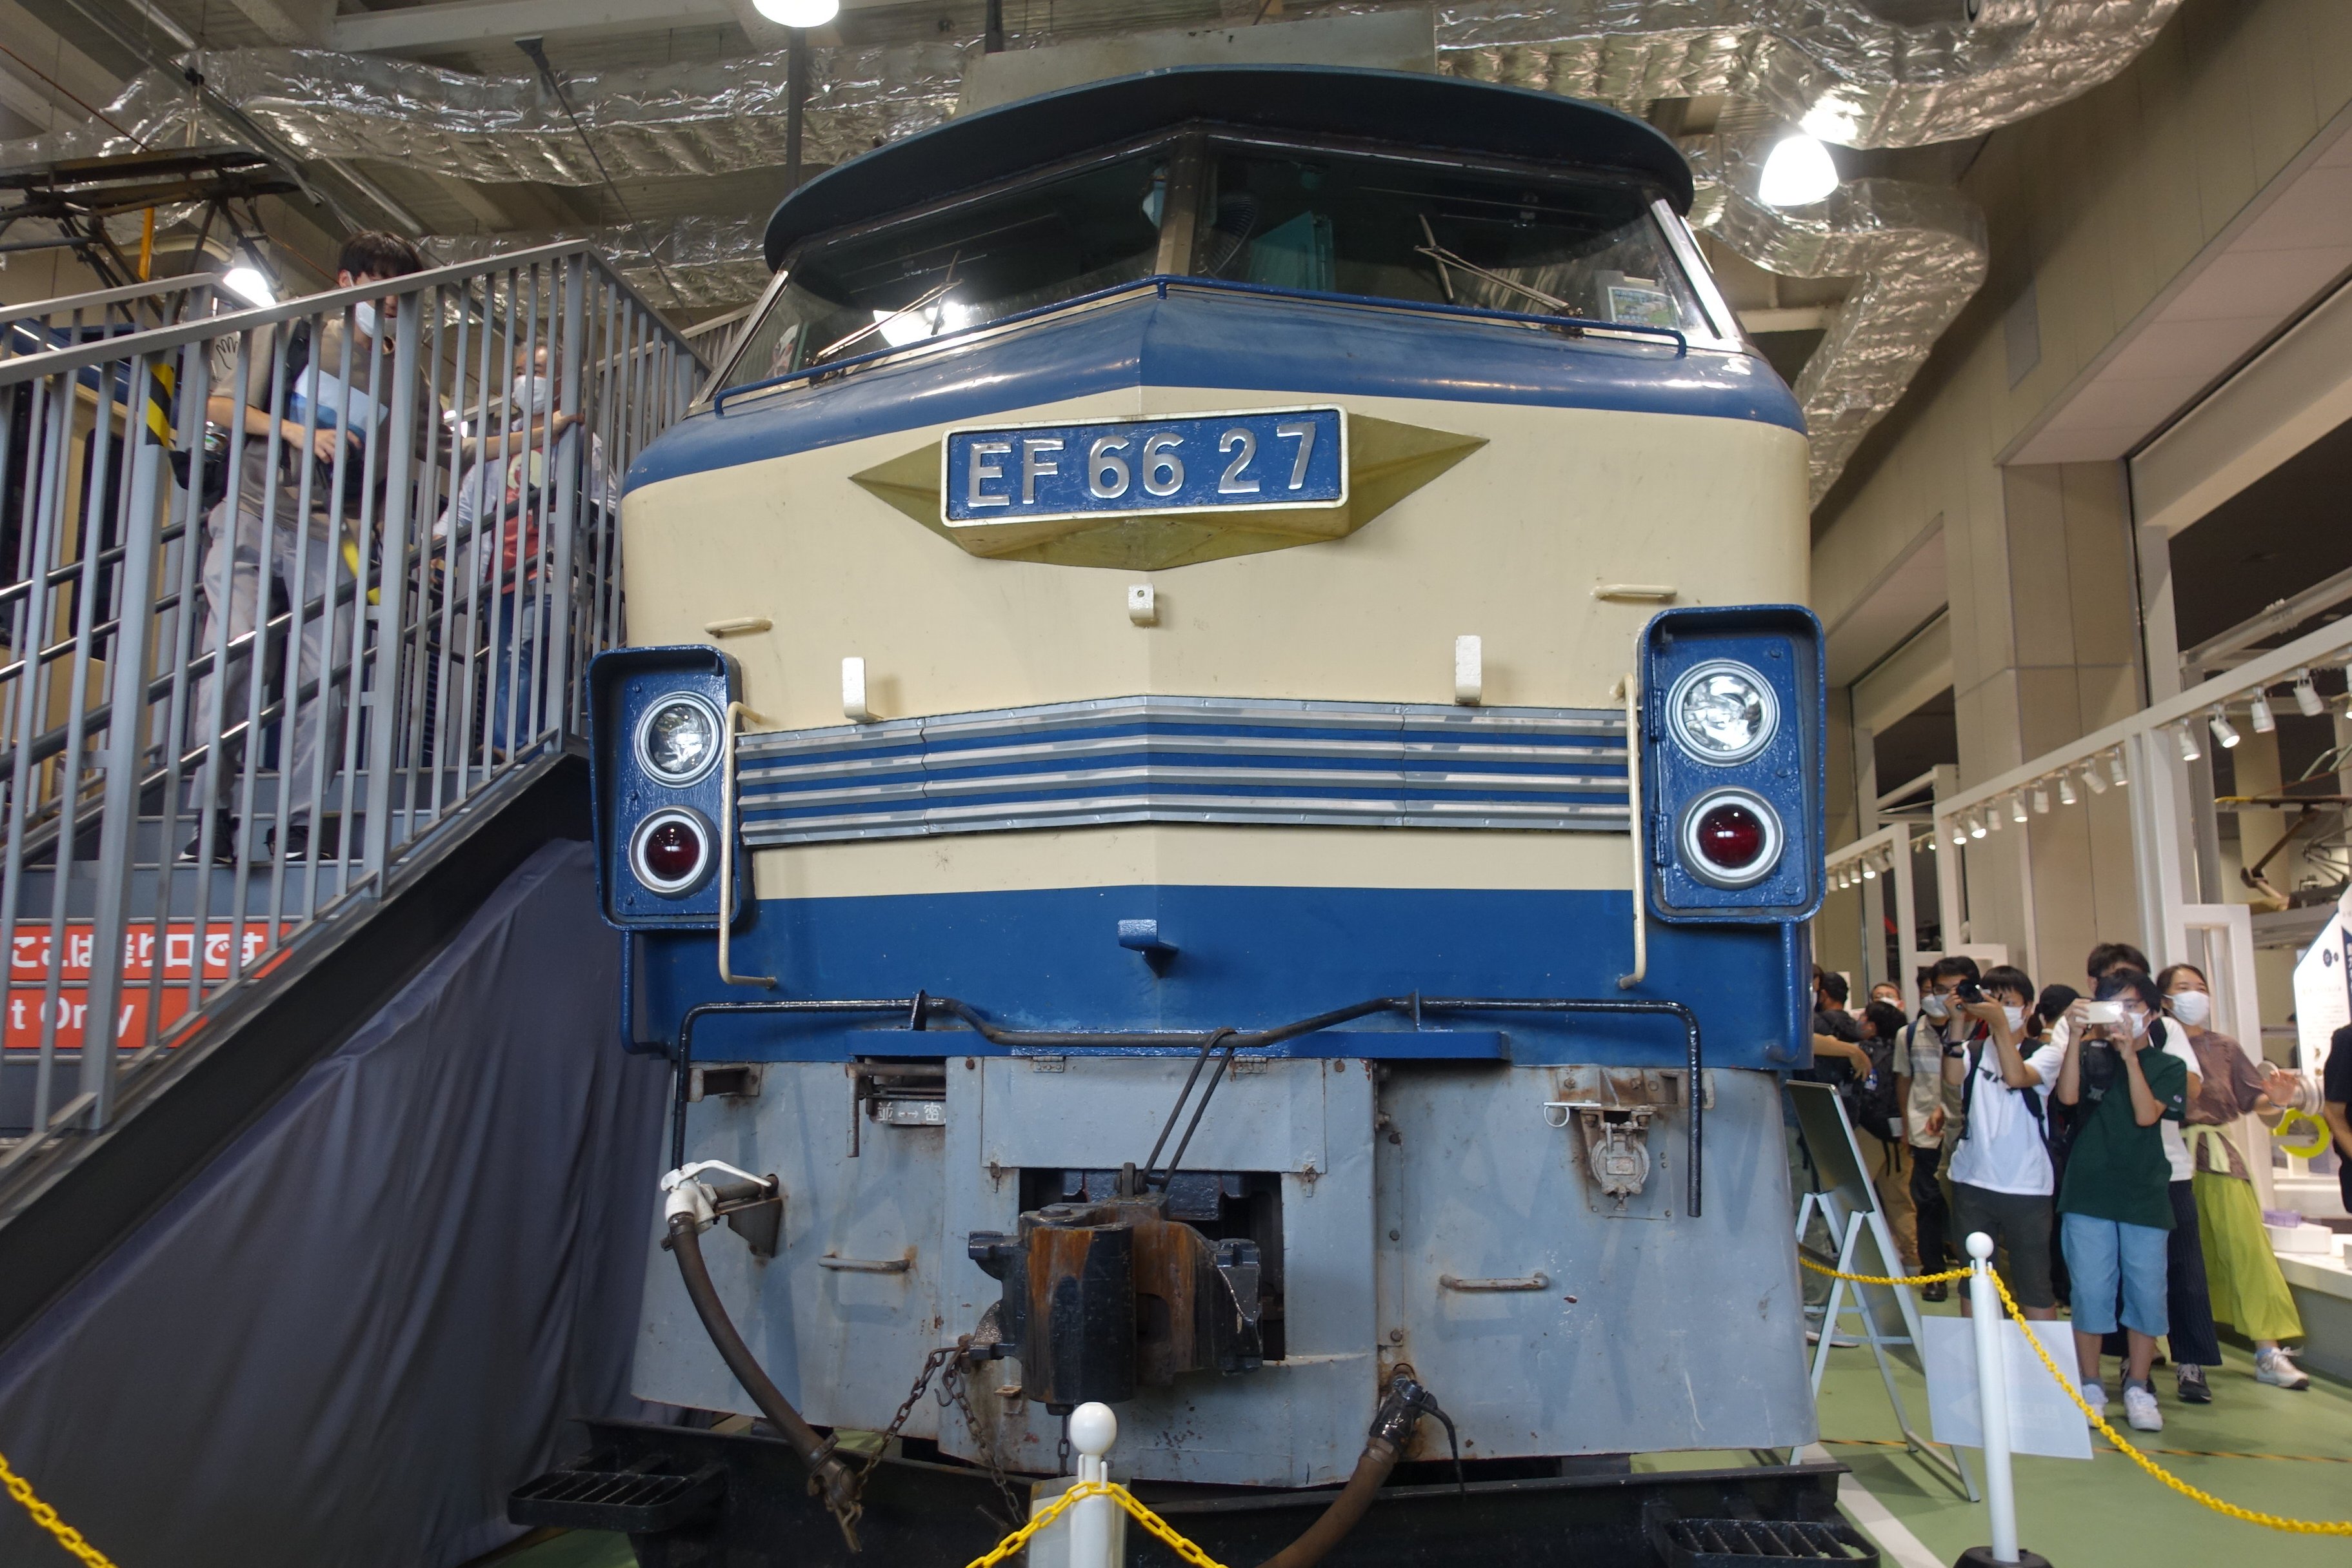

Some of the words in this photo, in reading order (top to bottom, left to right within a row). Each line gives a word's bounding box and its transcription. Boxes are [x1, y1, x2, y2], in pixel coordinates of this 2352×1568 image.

[968, 437, 1065, 508] EF
[1088, 432, 1186, 499] 66
[1217, 421, 1317, 494] 27
